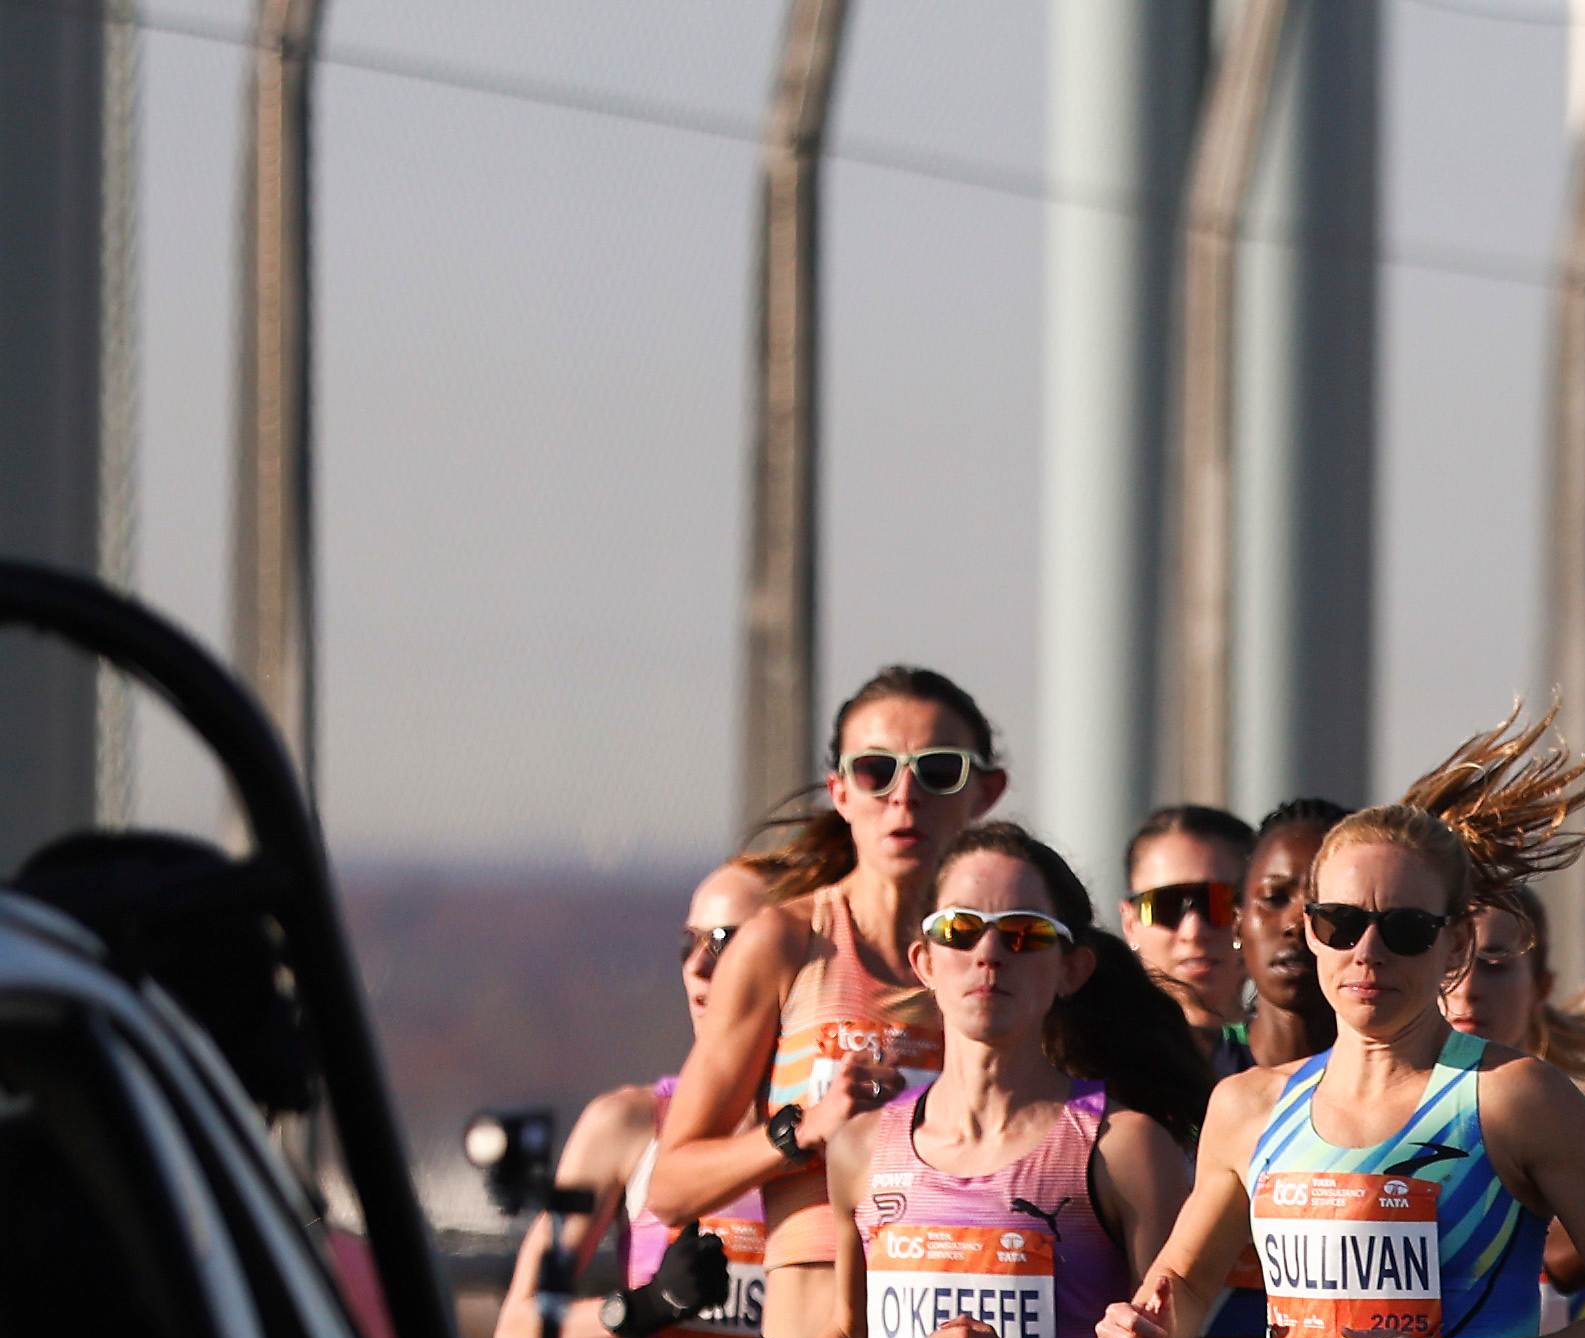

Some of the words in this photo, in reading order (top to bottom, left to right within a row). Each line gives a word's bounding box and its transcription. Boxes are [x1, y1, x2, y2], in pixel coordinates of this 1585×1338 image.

[1274, 1178, 1308, 1206] tcs
[1379, 1197, 1409, 1208] TATA
[887, 1231, 925, 1259] tcs
[996, 1251, 1028, 1264] TATA
[1265, 1233, 1430, 1291] SULLIVAN
[1371, 1313, 1430, 1333] 2025
